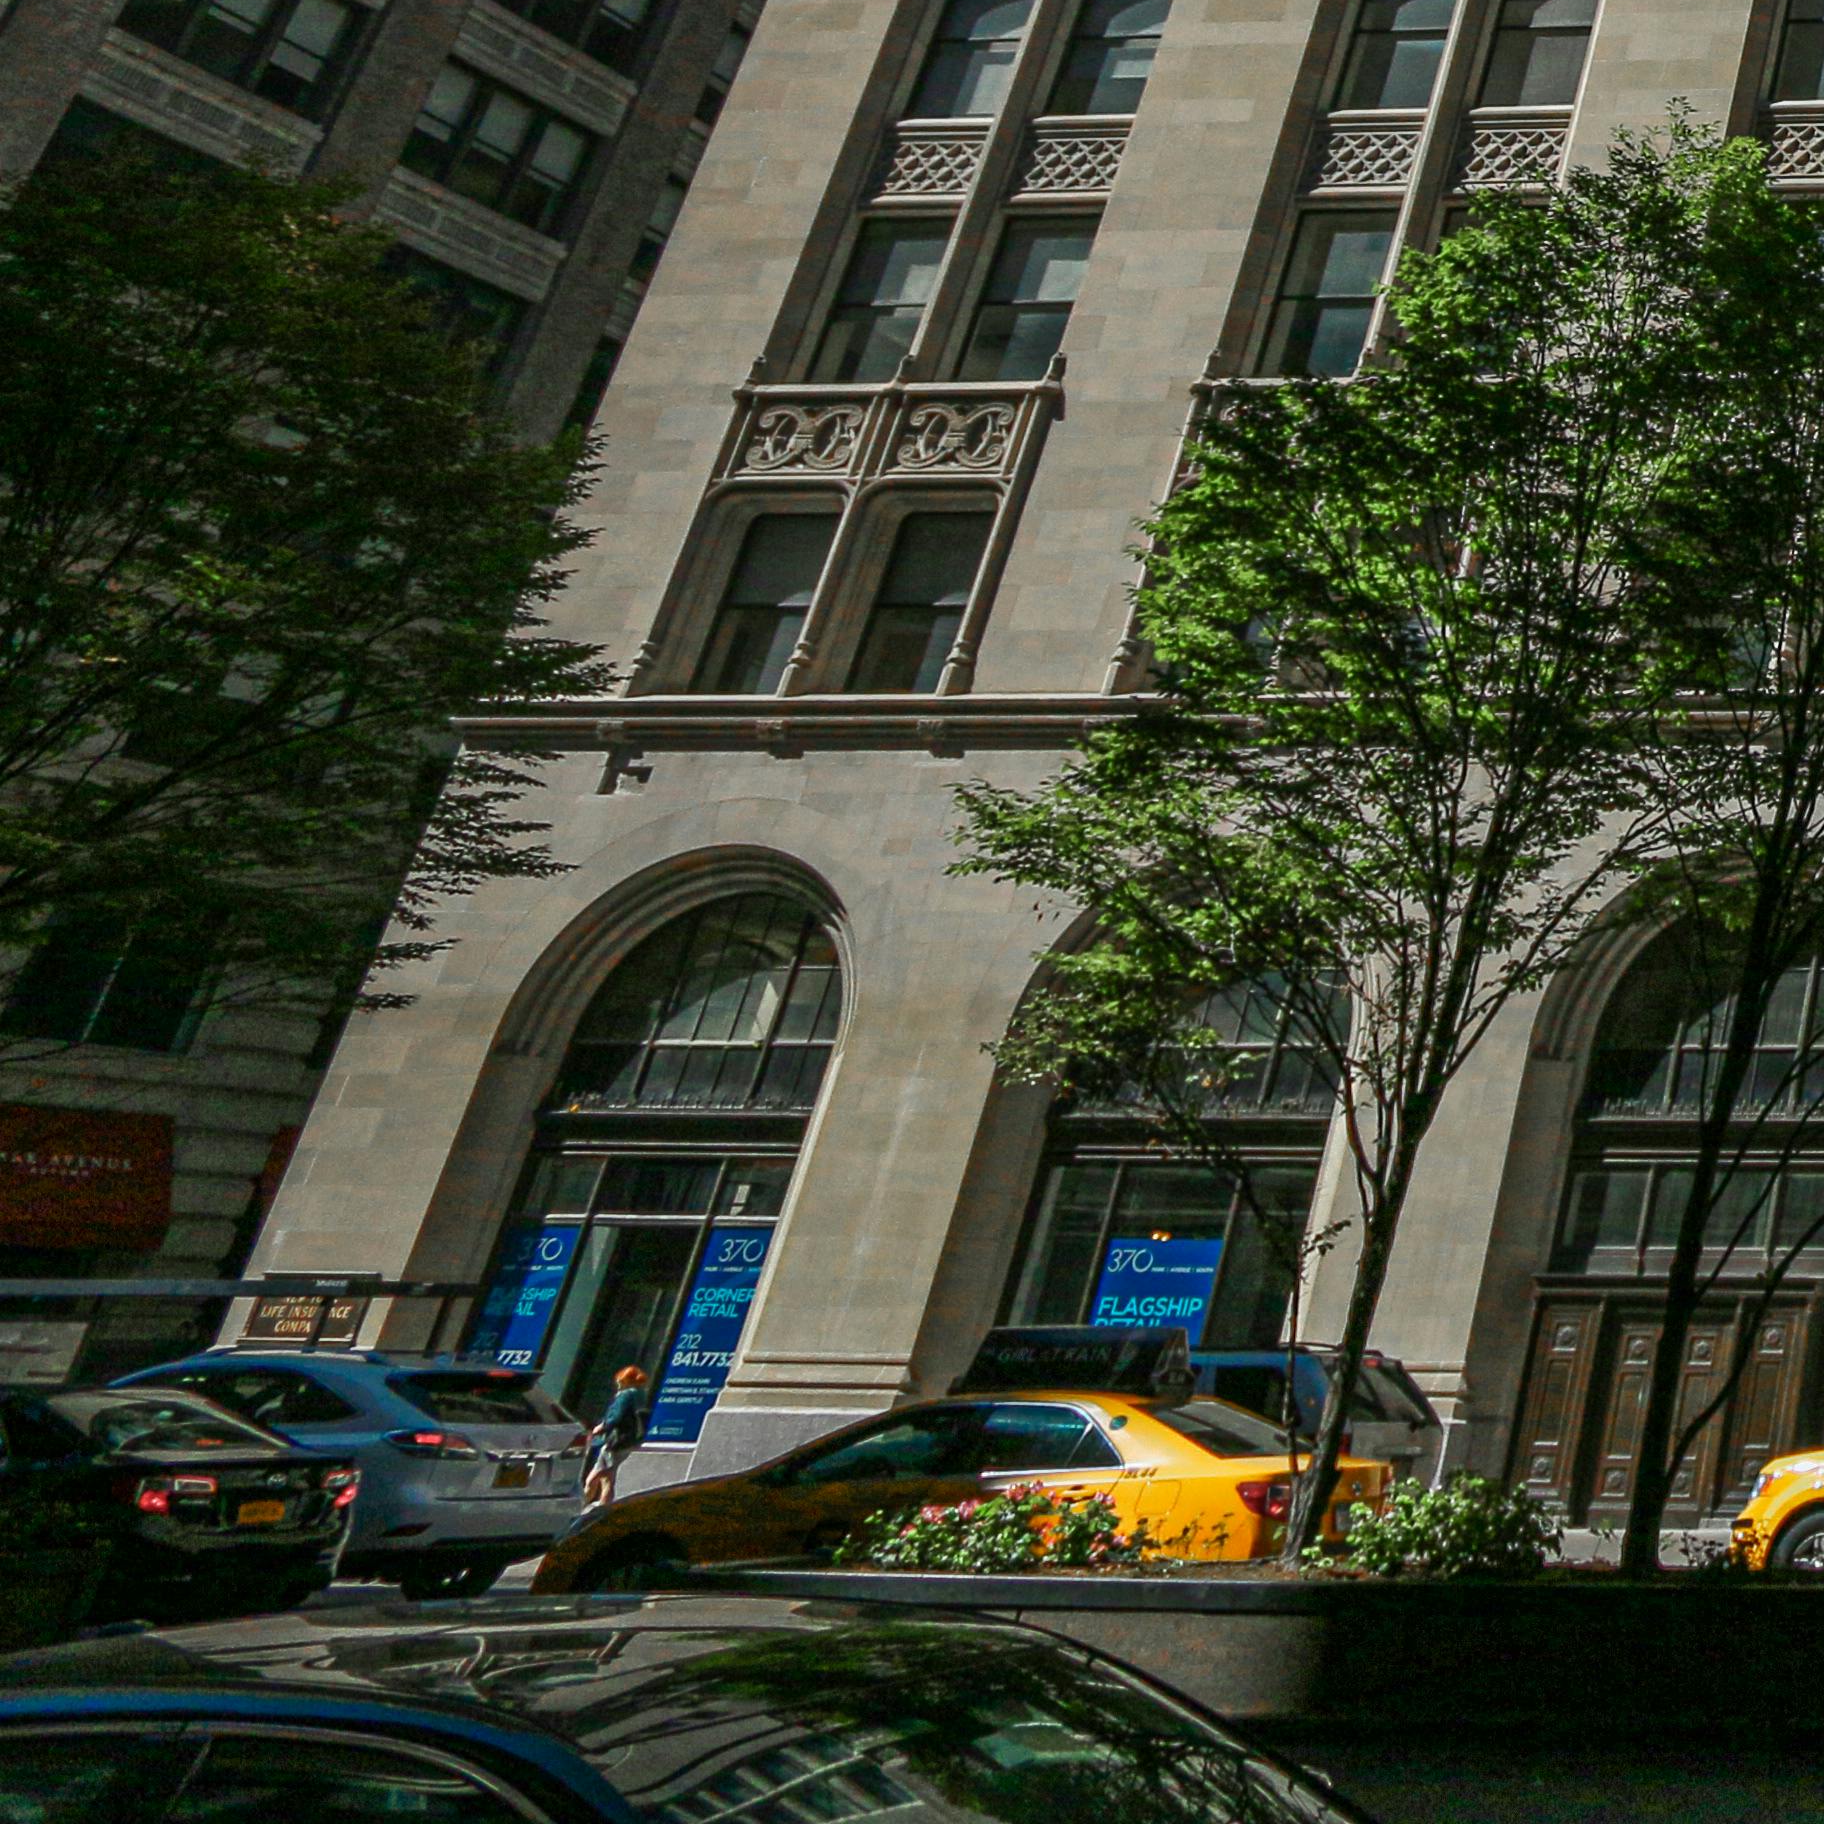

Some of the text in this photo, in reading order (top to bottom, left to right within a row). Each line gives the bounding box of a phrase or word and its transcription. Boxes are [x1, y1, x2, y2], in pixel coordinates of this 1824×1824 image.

[718, 1238, 765, 1263] 370
[1106, 1248, 1154, 1273] 370
[693, 1287, 757, 1303] CORNER
[260, 1305, 353, 1319] LIFE INSUNCE
[687, 1302, 739, 1318] RETAIL
[1097, 1295, 1203, 1317] FLAGSHIP
[273, 1319, 312, 1334] COMPA
[677, 1333, 702, 1350] 212
[671, 1350, 736, 1368] 841.7732
